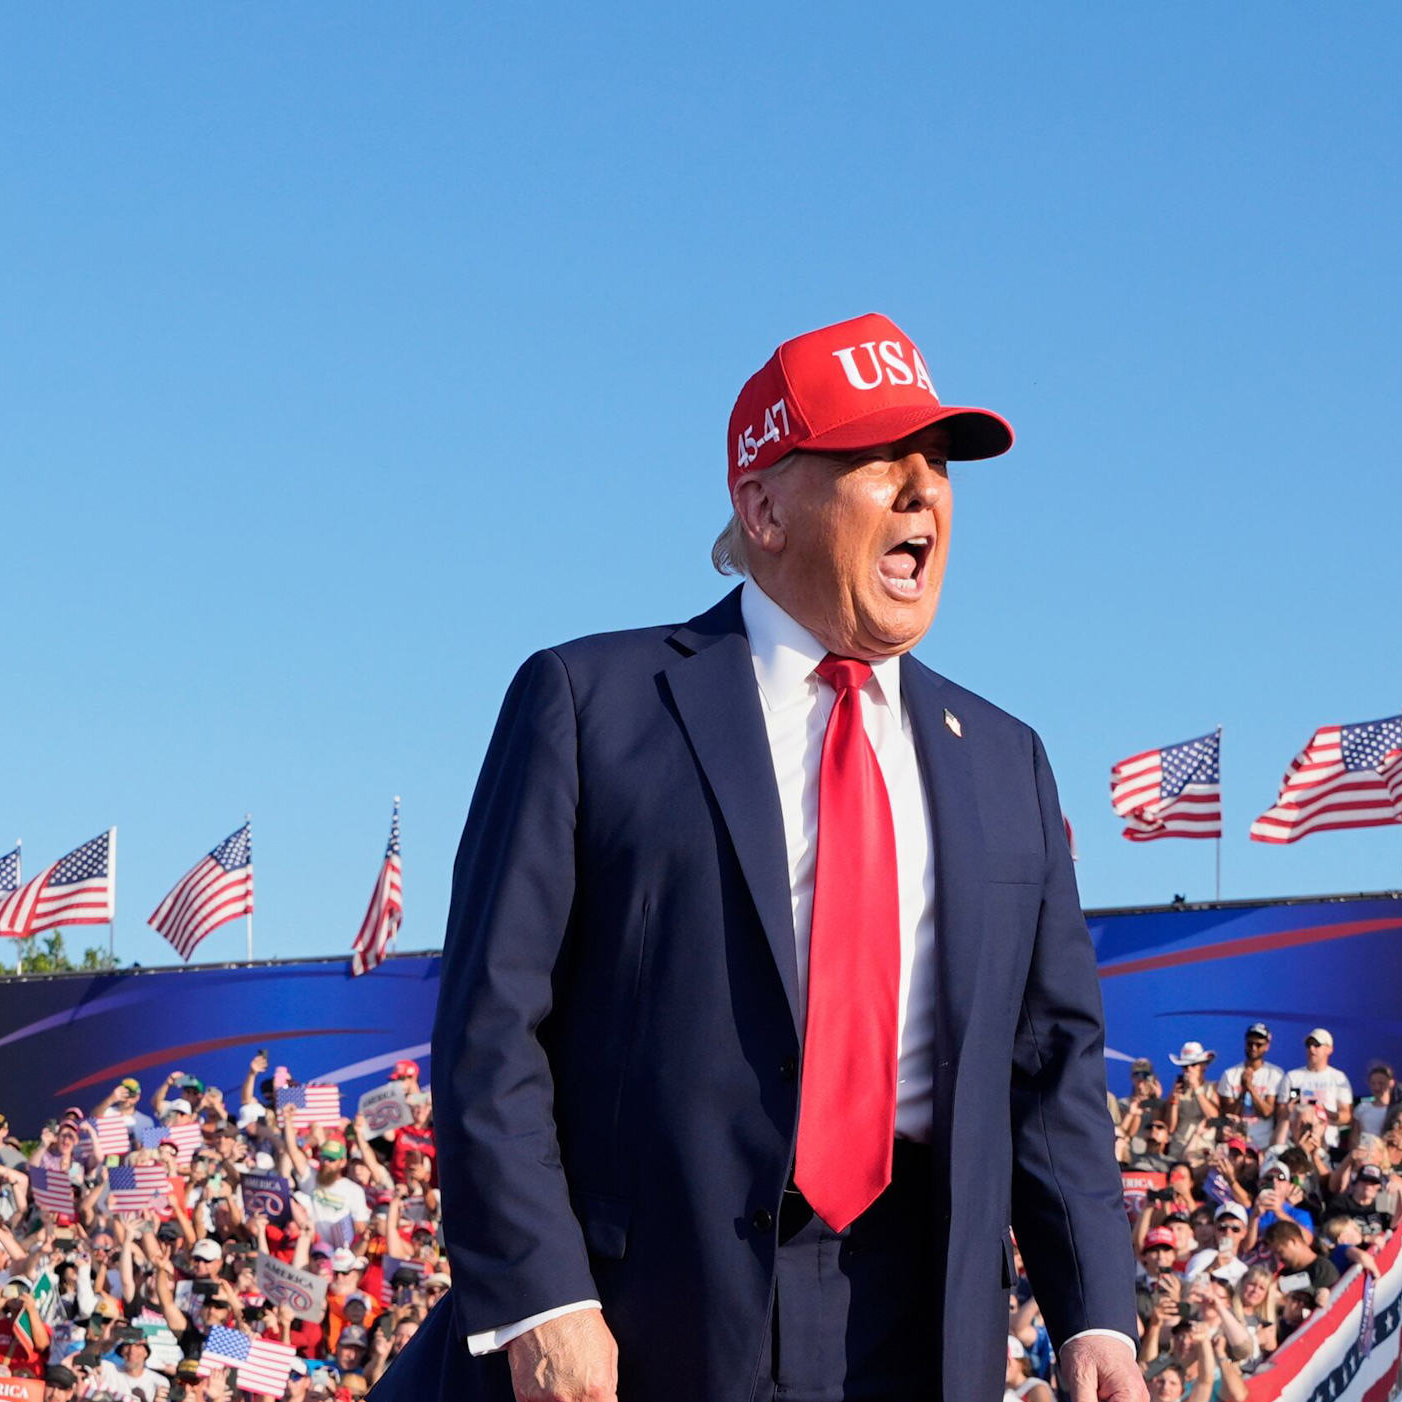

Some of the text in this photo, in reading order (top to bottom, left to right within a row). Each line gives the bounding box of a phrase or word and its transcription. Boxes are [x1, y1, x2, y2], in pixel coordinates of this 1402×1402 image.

[832, 340, 939, 401] USA
[737, 398, 790, 469] 45-47
[263, 1262, 314, 1290] AMERICA
